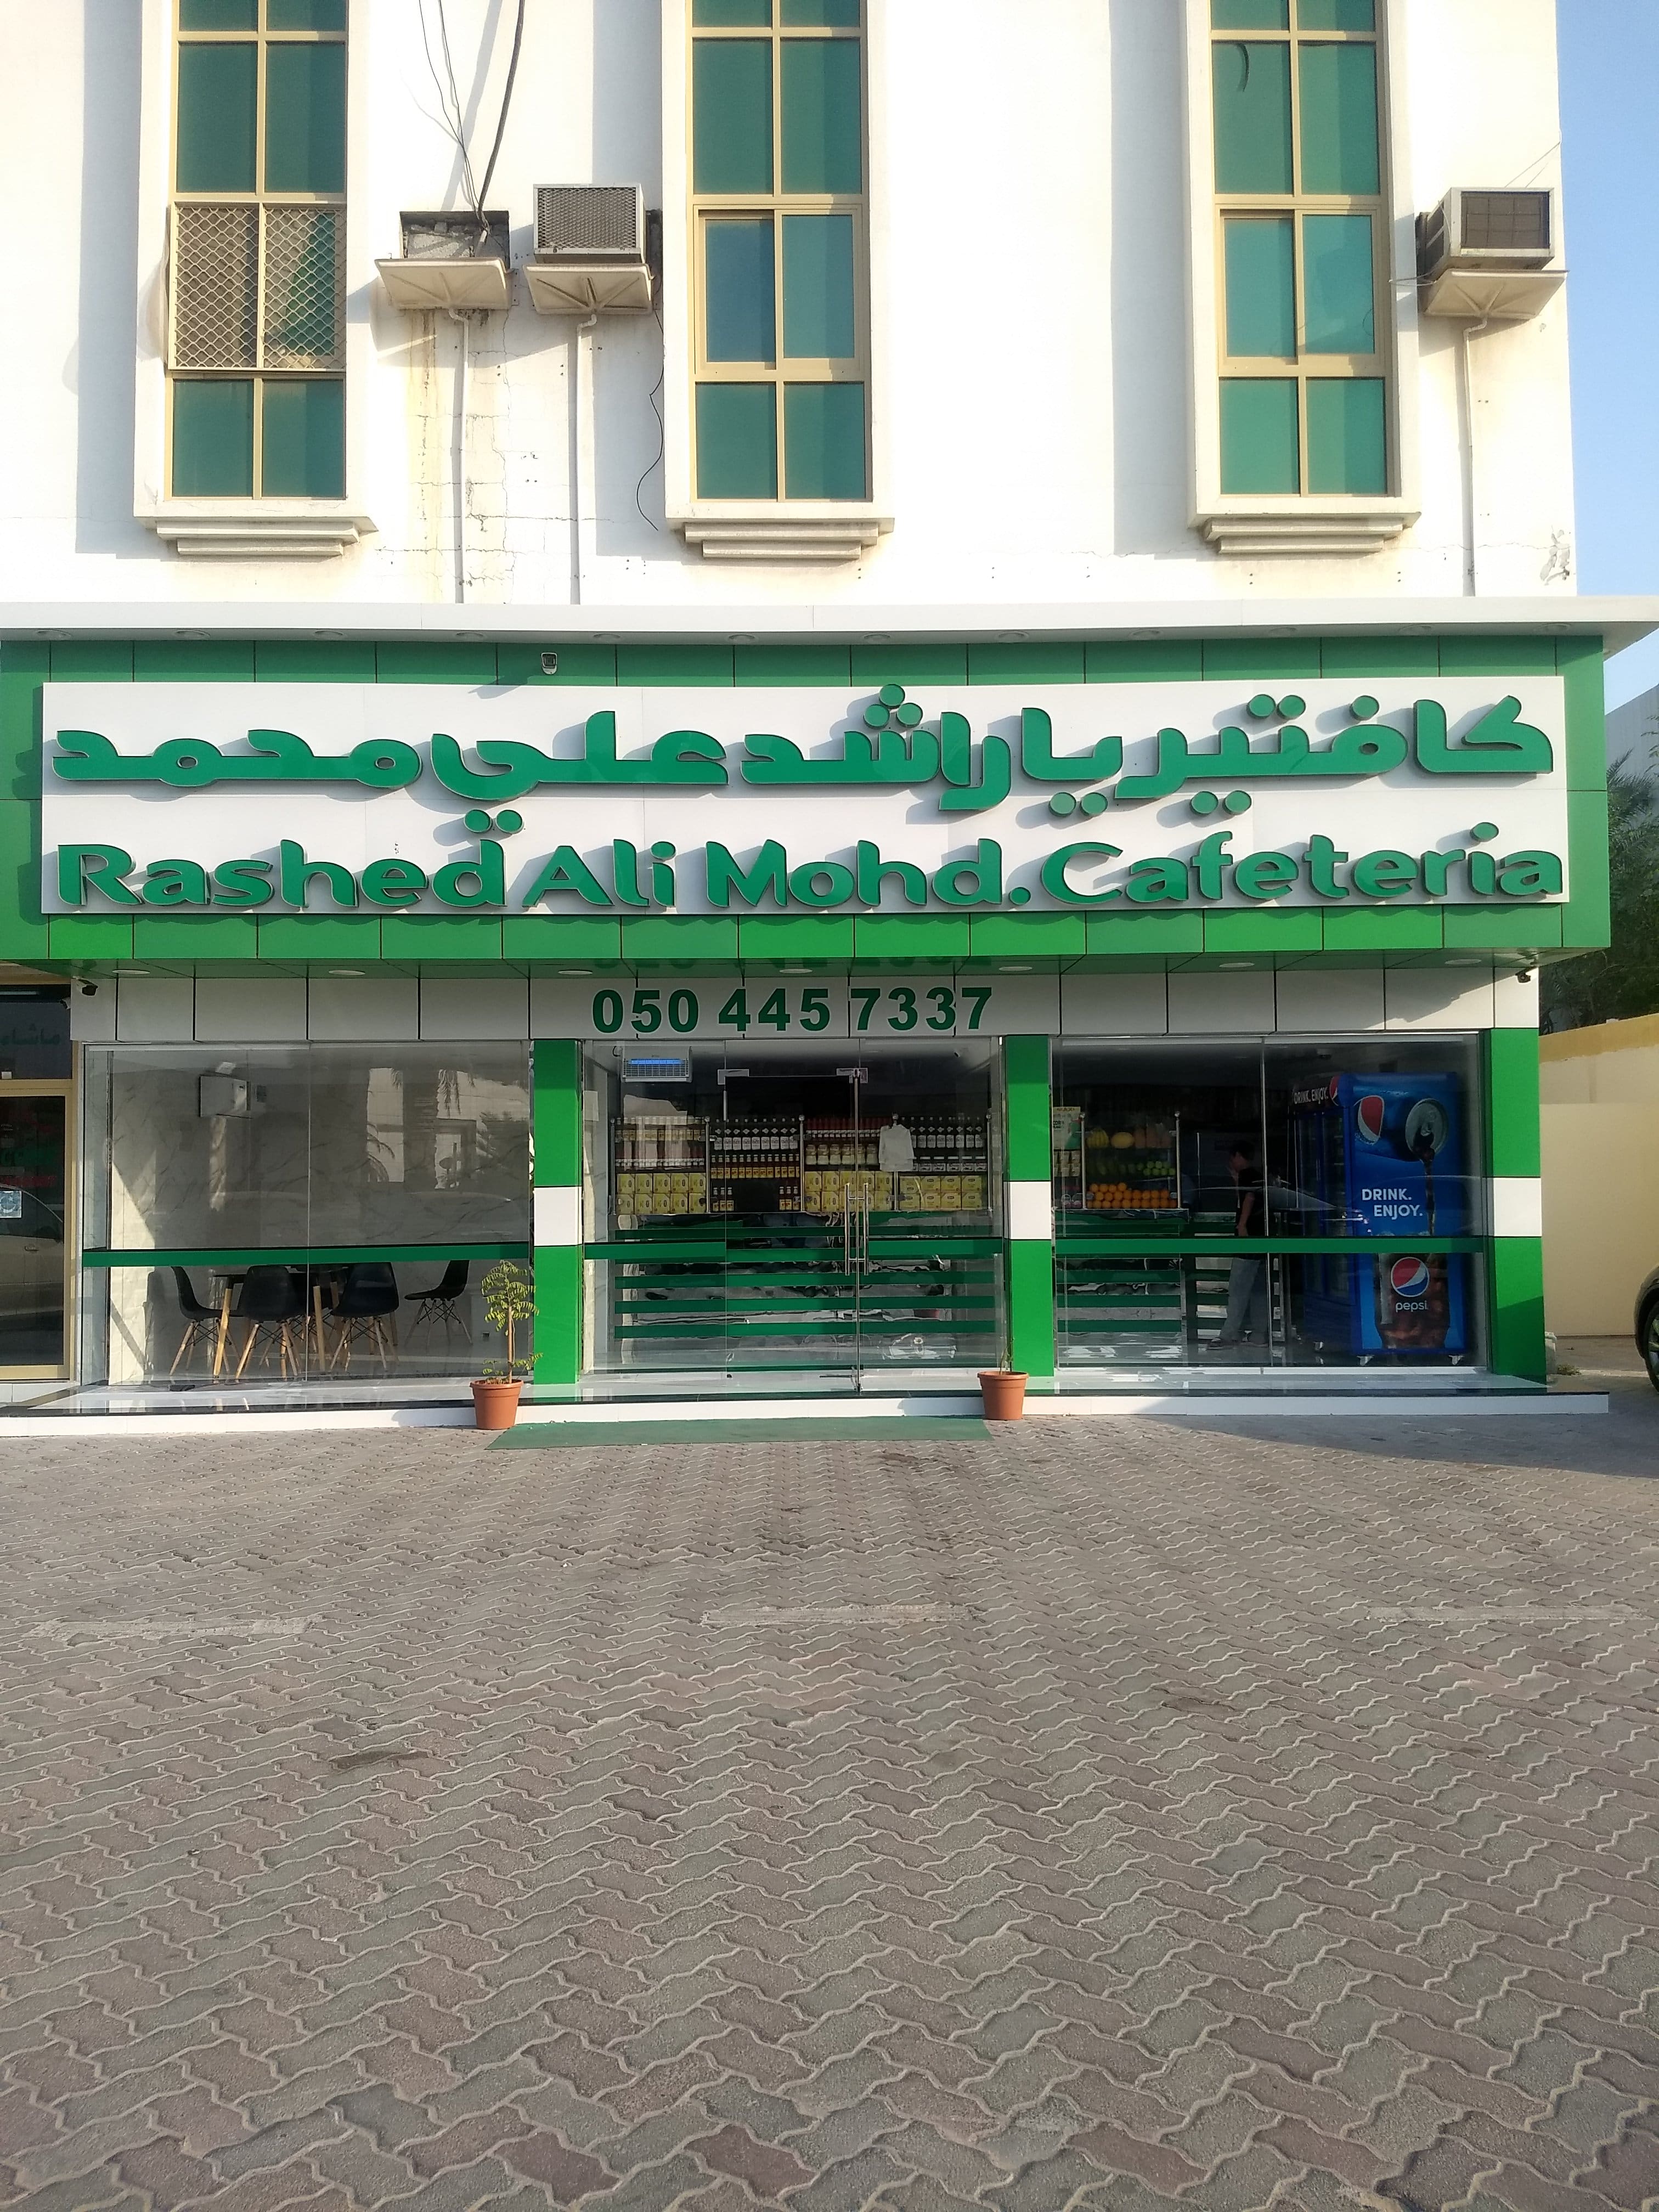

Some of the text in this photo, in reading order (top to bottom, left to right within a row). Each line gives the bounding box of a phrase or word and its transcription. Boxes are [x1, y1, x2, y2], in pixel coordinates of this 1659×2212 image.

[52, 730, 422, 788] محمد
[740, 683, 1012, 812] راشد
[1022, 693, 1554, 816] كافتيريا
[58, 823, 1562, 908] Rashed Ali Mohd. Cafeteria
[592, 986, 992, 1034] 050 445 7337
[1294, 1087, 1328, 1104] DRINK. ENJOY.
[1362, 1188, 1412, 1200] DRINK.
[1374, 1204, 1423, 1220] ENJOY.
[1395, 1300, 1428, 1312] pepsi
